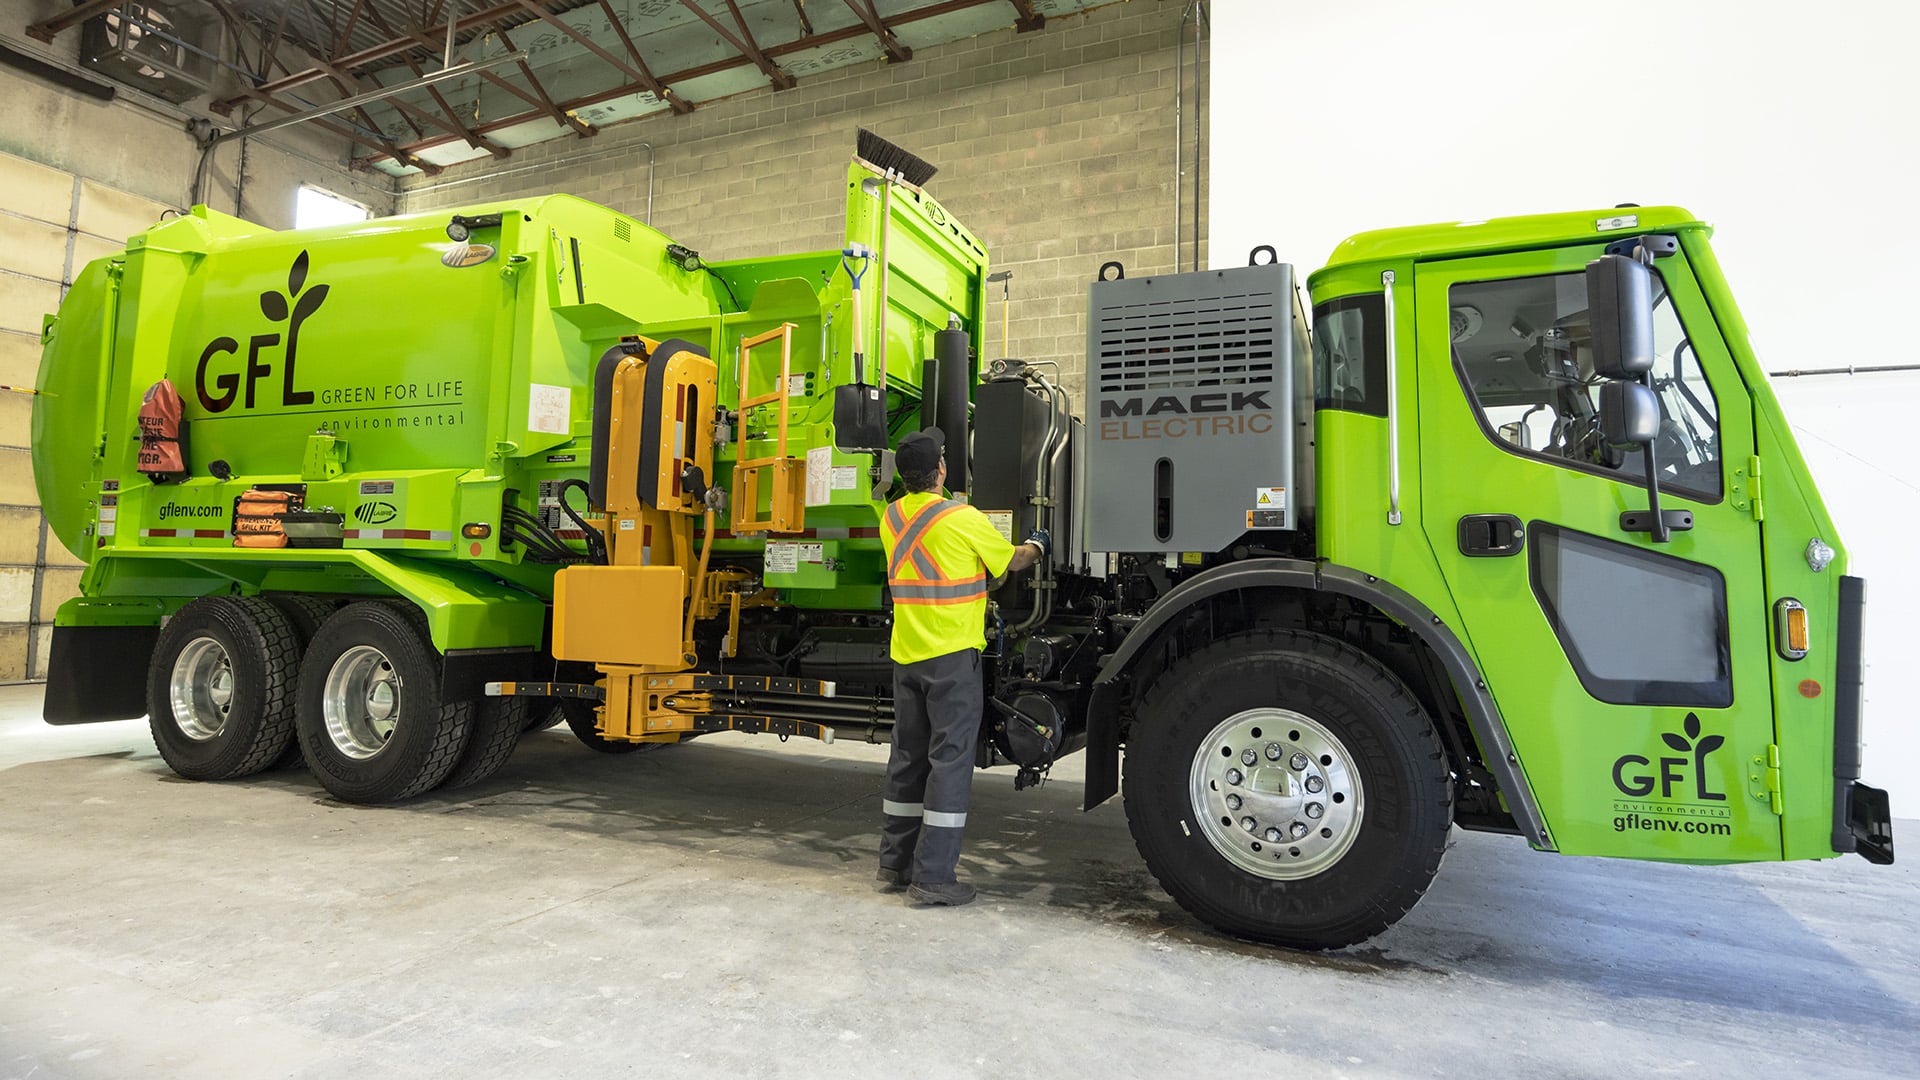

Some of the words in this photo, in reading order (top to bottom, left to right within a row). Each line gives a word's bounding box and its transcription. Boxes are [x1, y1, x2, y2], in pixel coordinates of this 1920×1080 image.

[195, 284, 330, 413] GFL
[321, 386, 375, 405] GREEN
[384, 383, 417, 400] FOR
[427, 381, 463, 398] LIFE
[1100, 390, 1272, 418] MACK
[322, 410, 464, 431] environmental
[1101, 413, 1273, 440] ELECTRIC
[160, 502, 222, 520] gflenv.com
[1612, 735, 1726, 801] GFL
[1613, 803, 1731, 817] environmental
[1613, 814, 1731, 835] gflenv.com
